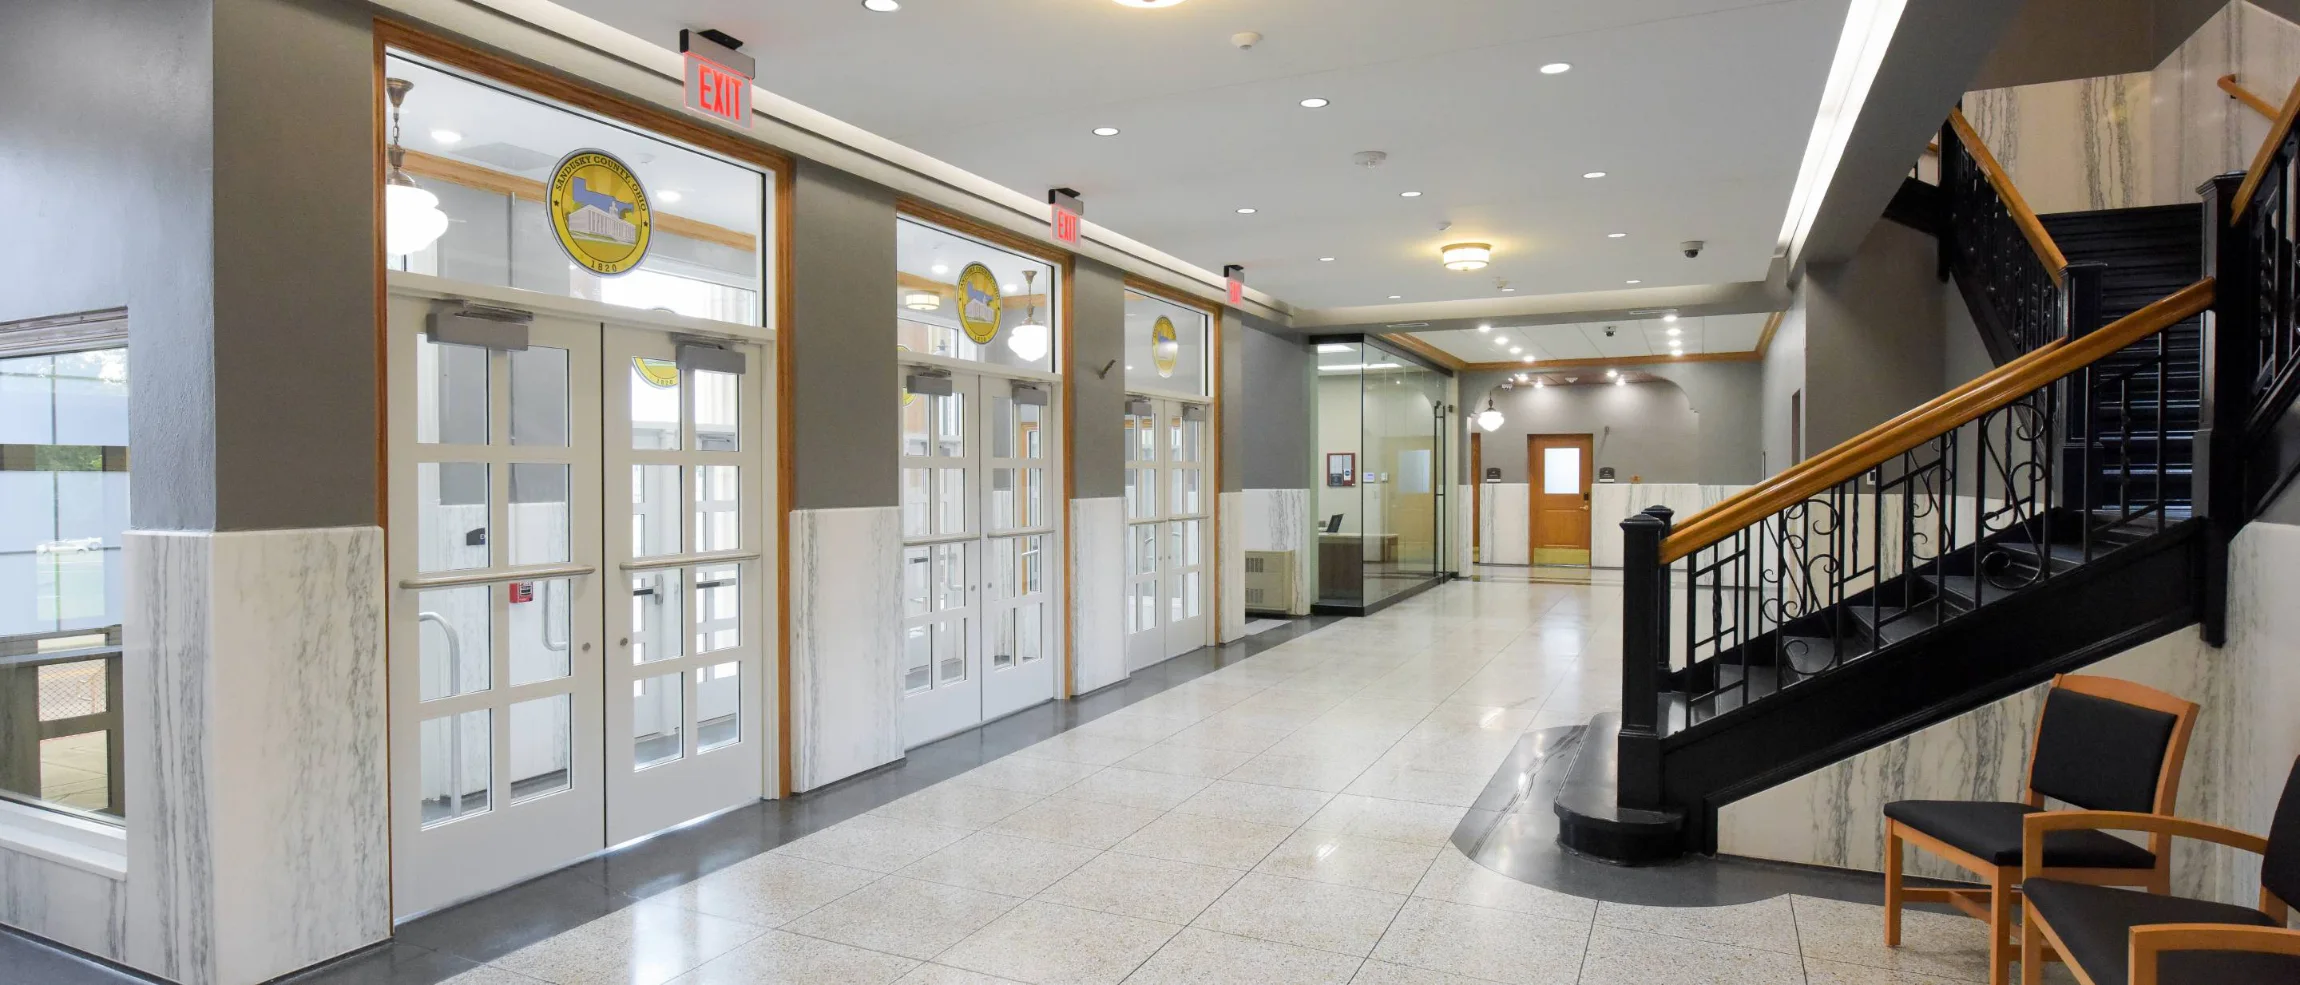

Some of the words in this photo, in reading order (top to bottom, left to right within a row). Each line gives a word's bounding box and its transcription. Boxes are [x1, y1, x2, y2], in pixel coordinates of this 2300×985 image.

[698, 64, 743, 120] EXIT
[556, 156, 591, 191] SANDUSKY
[593, 156, 631, 184] COUNTY,
[632, 183, 647, 212] OHIO
[1057, 210, 1077, 243] EXIT
[590, 260, 617, 272] 1820
